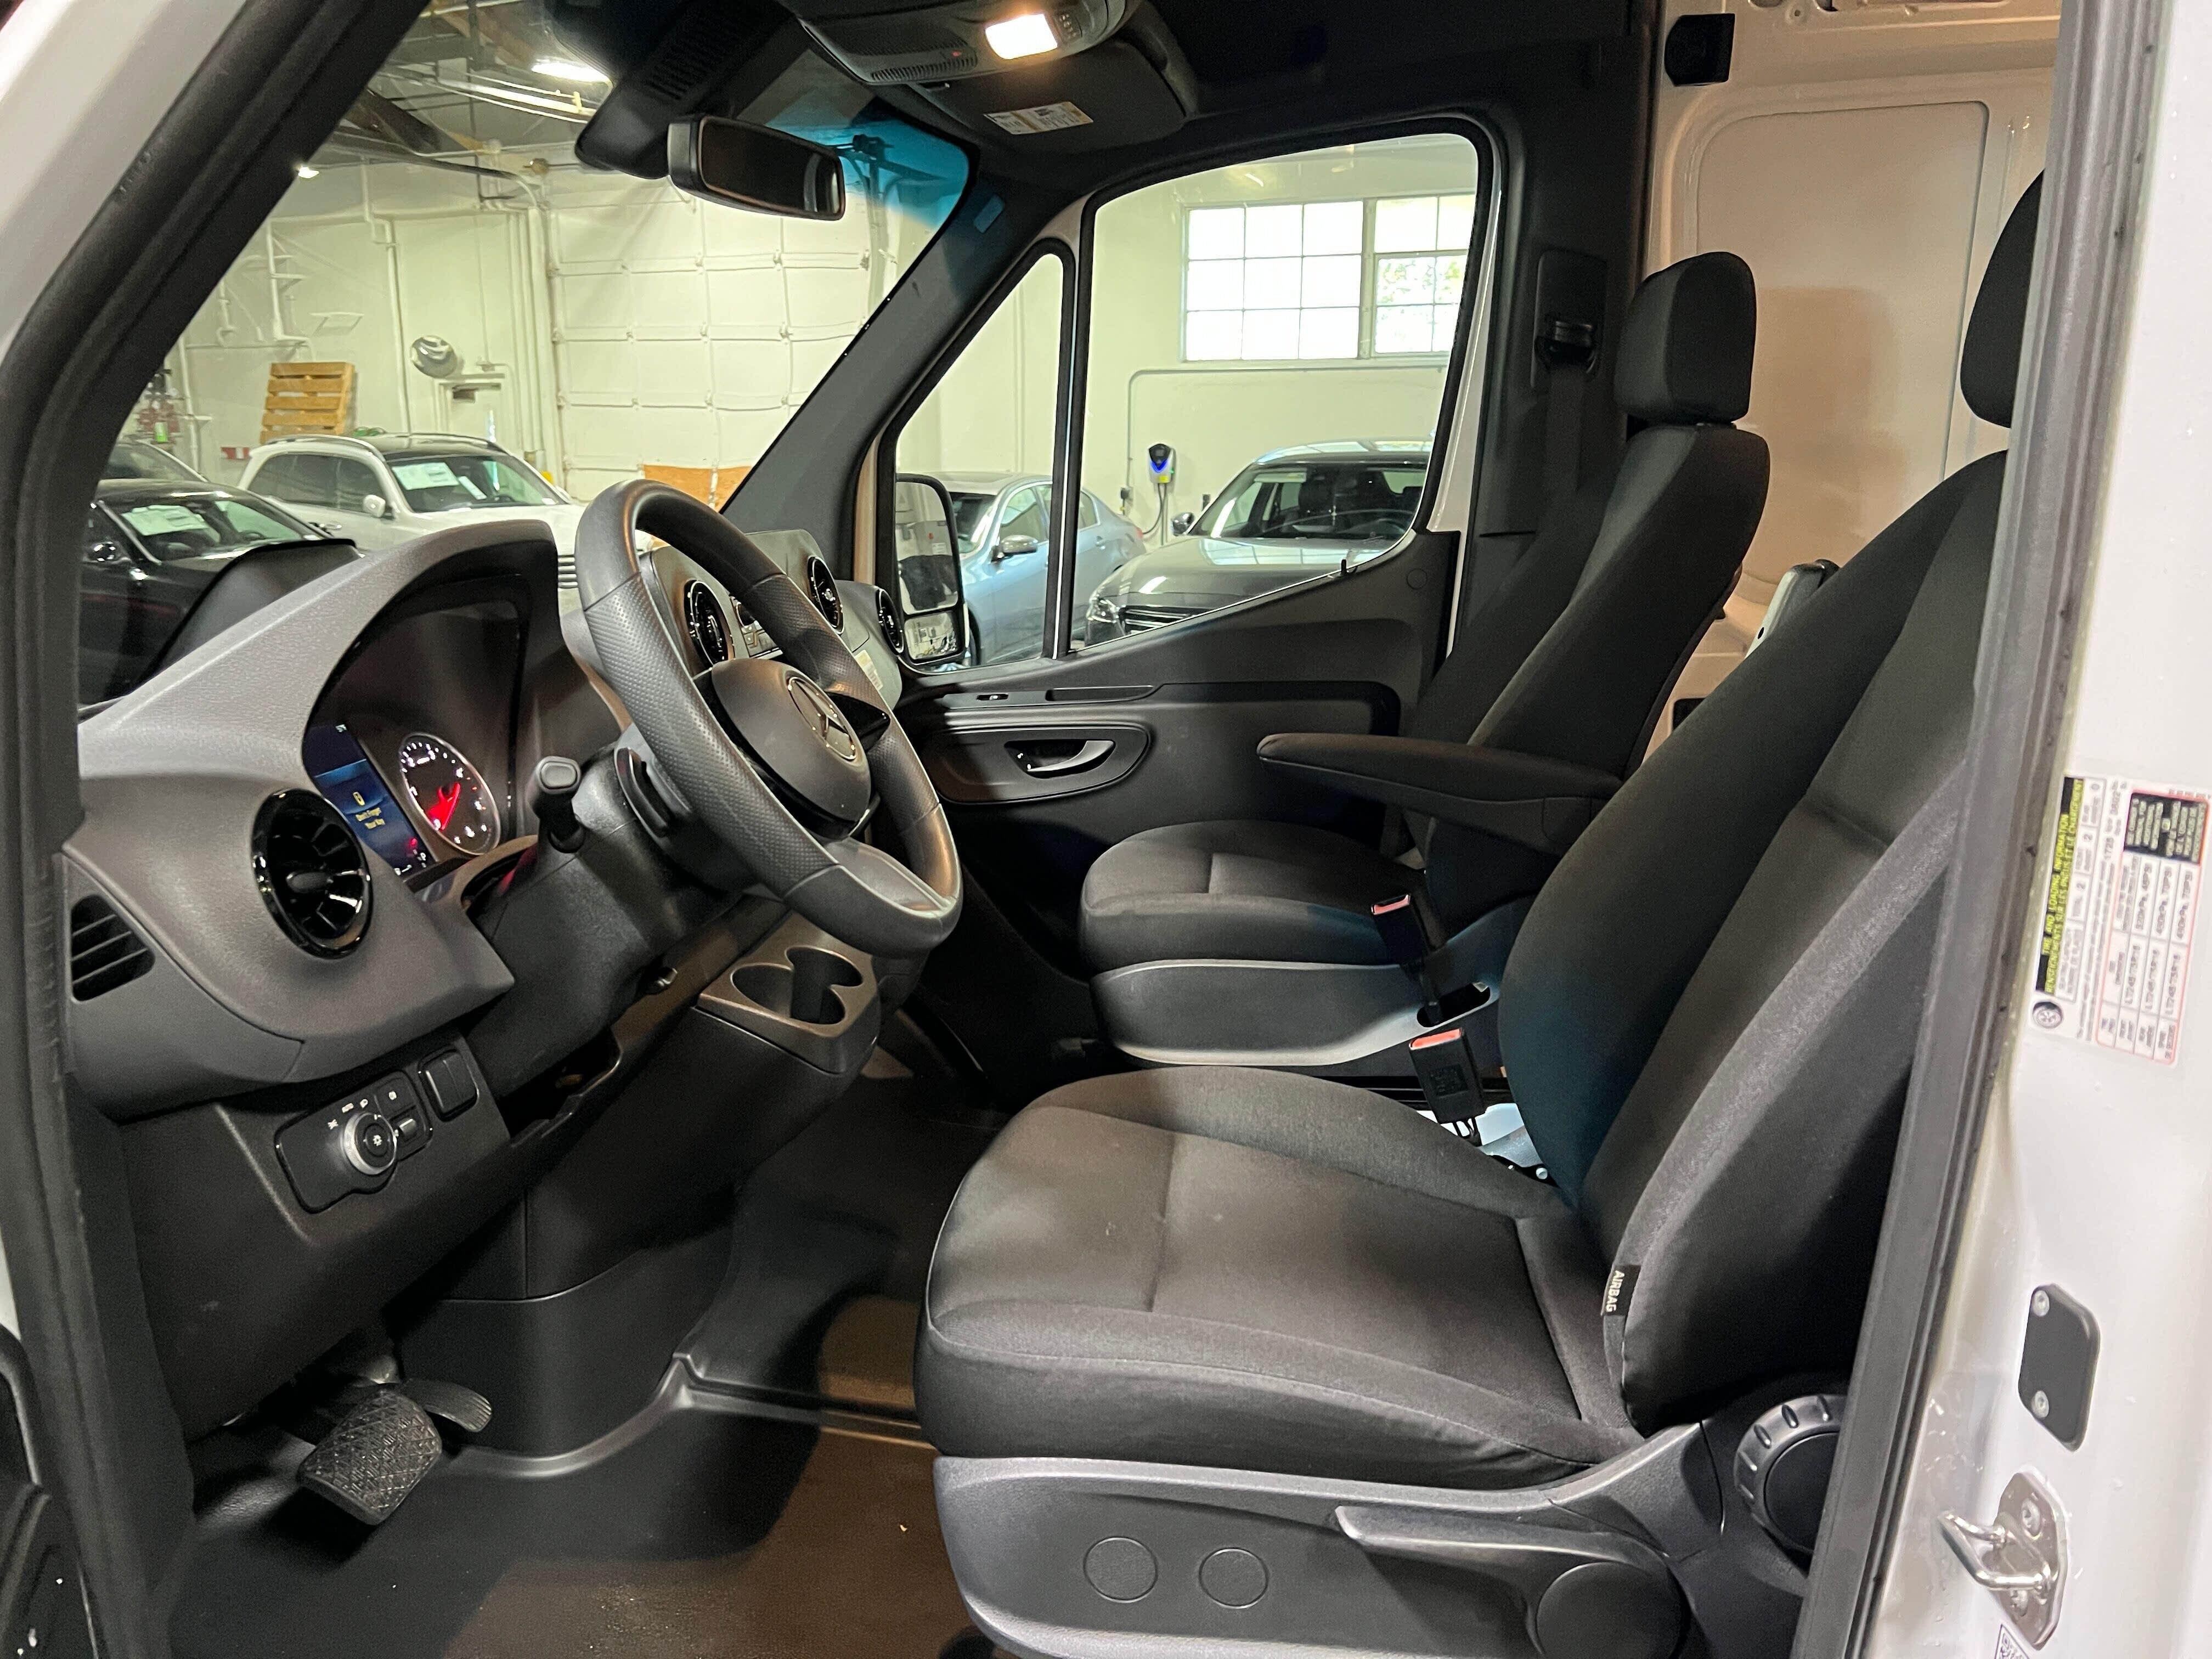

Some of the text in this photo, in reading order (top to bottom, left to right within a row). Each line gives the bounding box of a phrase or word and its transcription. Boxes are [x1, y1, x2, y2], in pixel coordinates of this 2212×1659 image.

[2083, 832, 2093, 841] 2
[2041, 812, 2069, 955] TIRE AND LOADING INFORMATION
[2044, 922, 2062, 994] RENSEIGNEMENTS
[2055, 904, 2065, 923] SUR
[2067, 779, 2083, 834] CHARGEMENT
[2076, 881, 2086, 890] 2
[1606, 1270, 1625, 1313] AIRBAG
